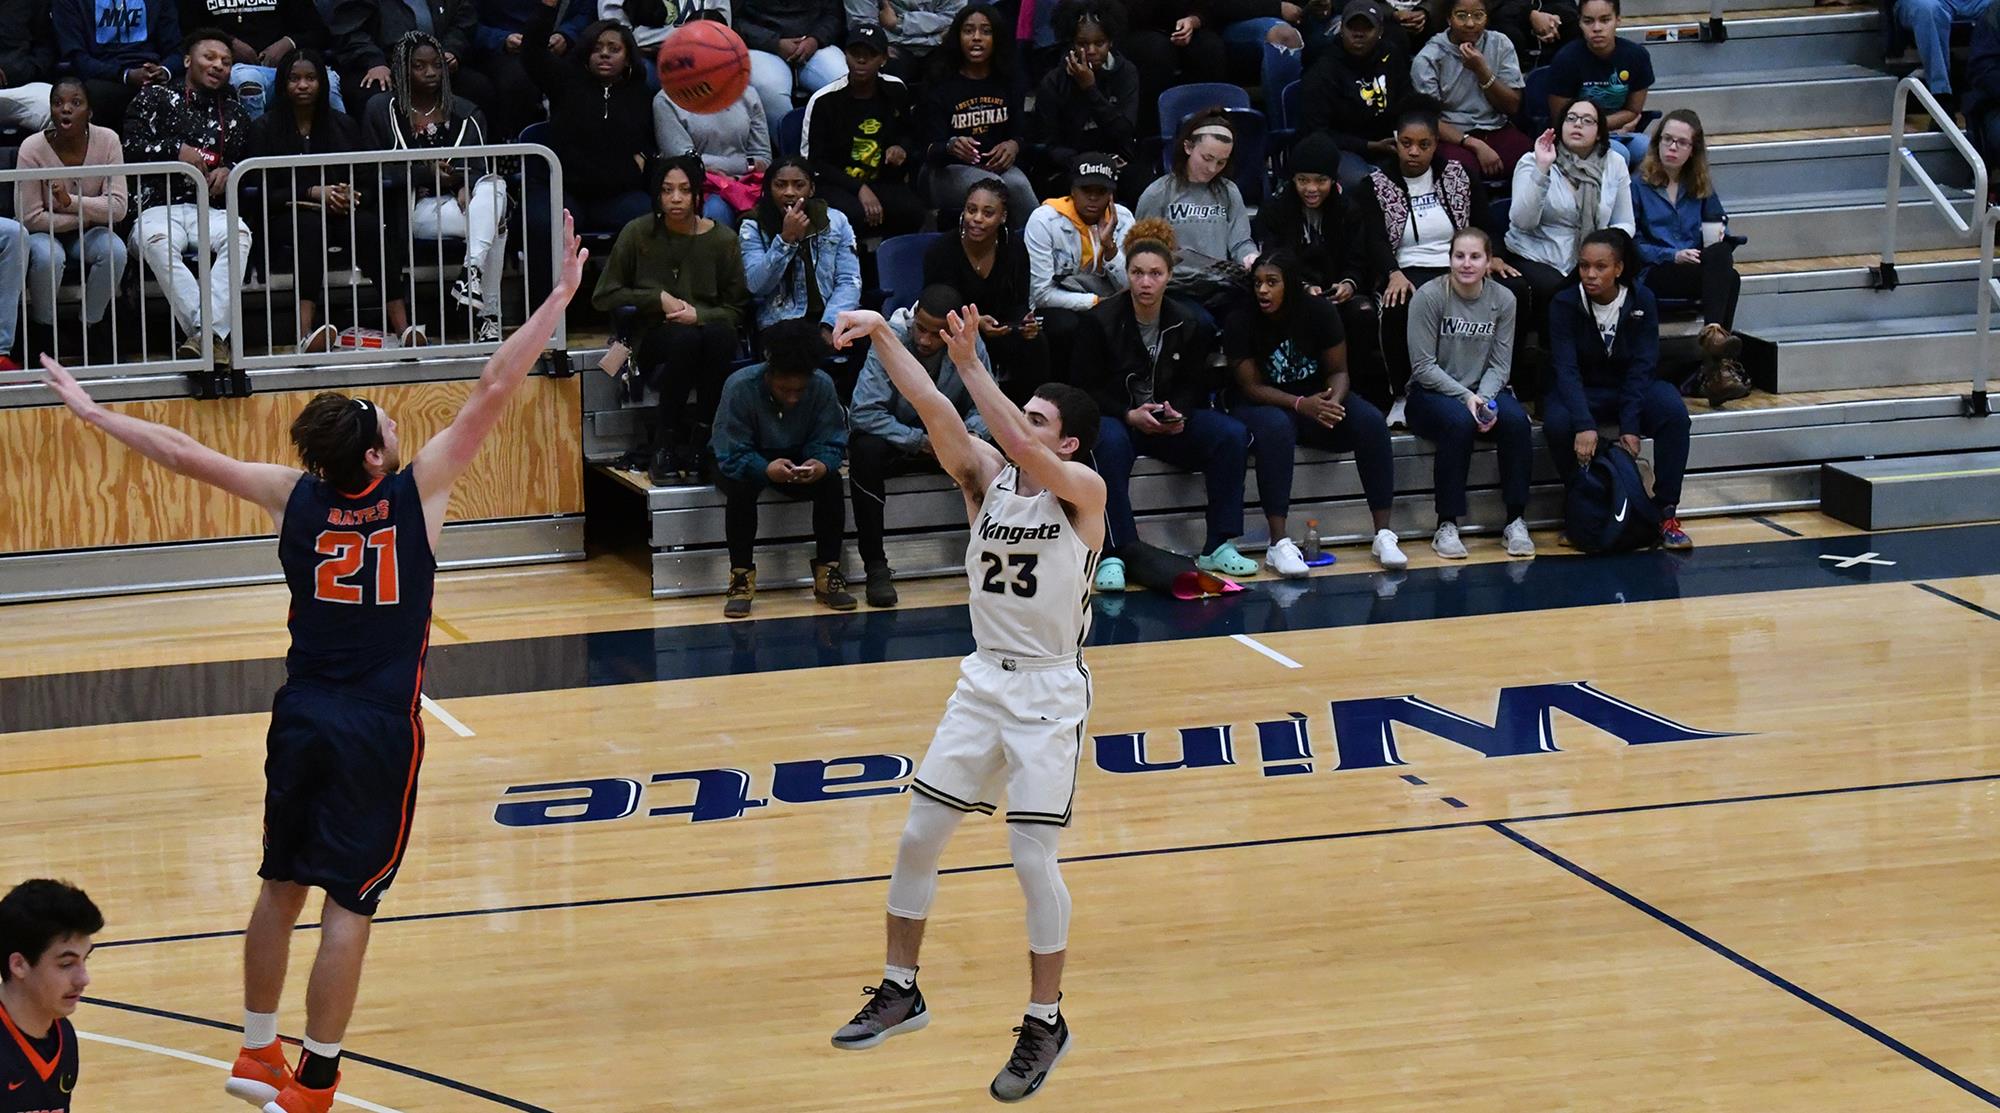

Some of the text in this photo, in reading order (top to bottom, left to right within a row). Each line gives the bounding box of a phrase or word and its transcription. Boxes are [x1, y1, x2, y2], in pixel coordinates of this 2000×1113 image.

[1168, 202, 1227, 220] Wingate
[327, 499, 390, 526] BATES
[978, 511, 1061, 545] Wingate
[314, 524, 400, 605] 21
[980, 550, 1039, 598] 23
